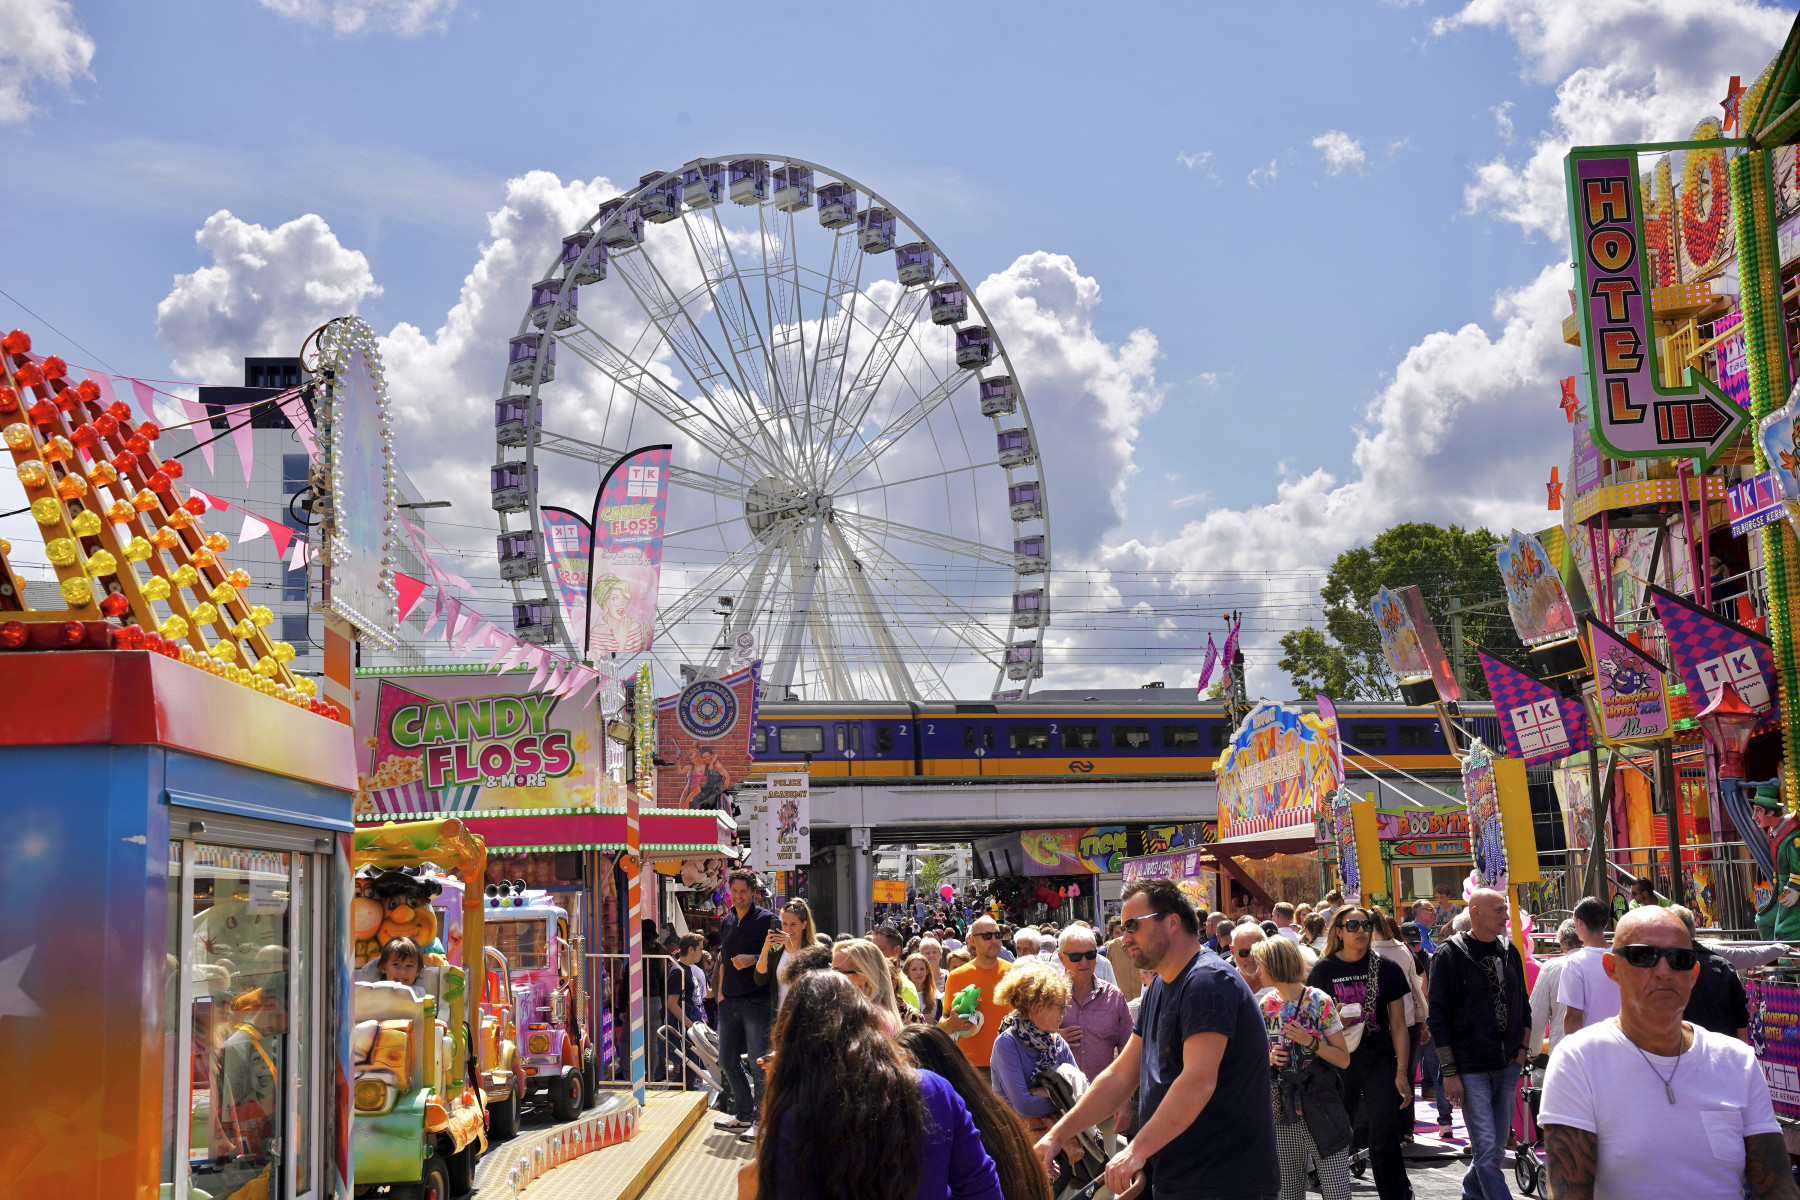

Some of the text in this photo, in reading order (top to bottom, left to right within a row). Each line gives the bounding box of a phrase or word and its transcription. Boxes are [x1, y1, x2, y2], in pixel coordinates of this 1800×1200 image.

[1582, 176, 1649, 425] HOTEL
[601, 504, 656, 521] CANDY
[611, 517, 658, 535] FLOSS
[1732, 515, 1765, 537] TILBURGSE
[1604, 690, 1660, 707] BOOBYTRAP
[1606, 701, 1661, 719] HOTEL XXL
[390, 693, 561, 749] CANDY
[1050, 723, 1058, 734] 2
[1433, 722, 1441, 733] 2
[1608, 717, 1659, 738] Albers
[769, 725, 777, 737] 2
[899, 725, 907, 736] 2
[927, 724, 935, 735] 2
[426, 732, 574, 789] FLOSS
[486, 773, 547, 788] & MORE
[773, 779, 802, 787] POLICE
[767, 790, 808, 799] ACADEMY
[1416, 841, 1465, 854] XXL HOTEL
[777, 852, 793, 860] WIN
[1763, 1012, 1799, 1027] BOOBYTRAP
[1764, 1026, 1783, 1041] HOTEL
[1780, 1090, 1800, 1103] KERMIS
